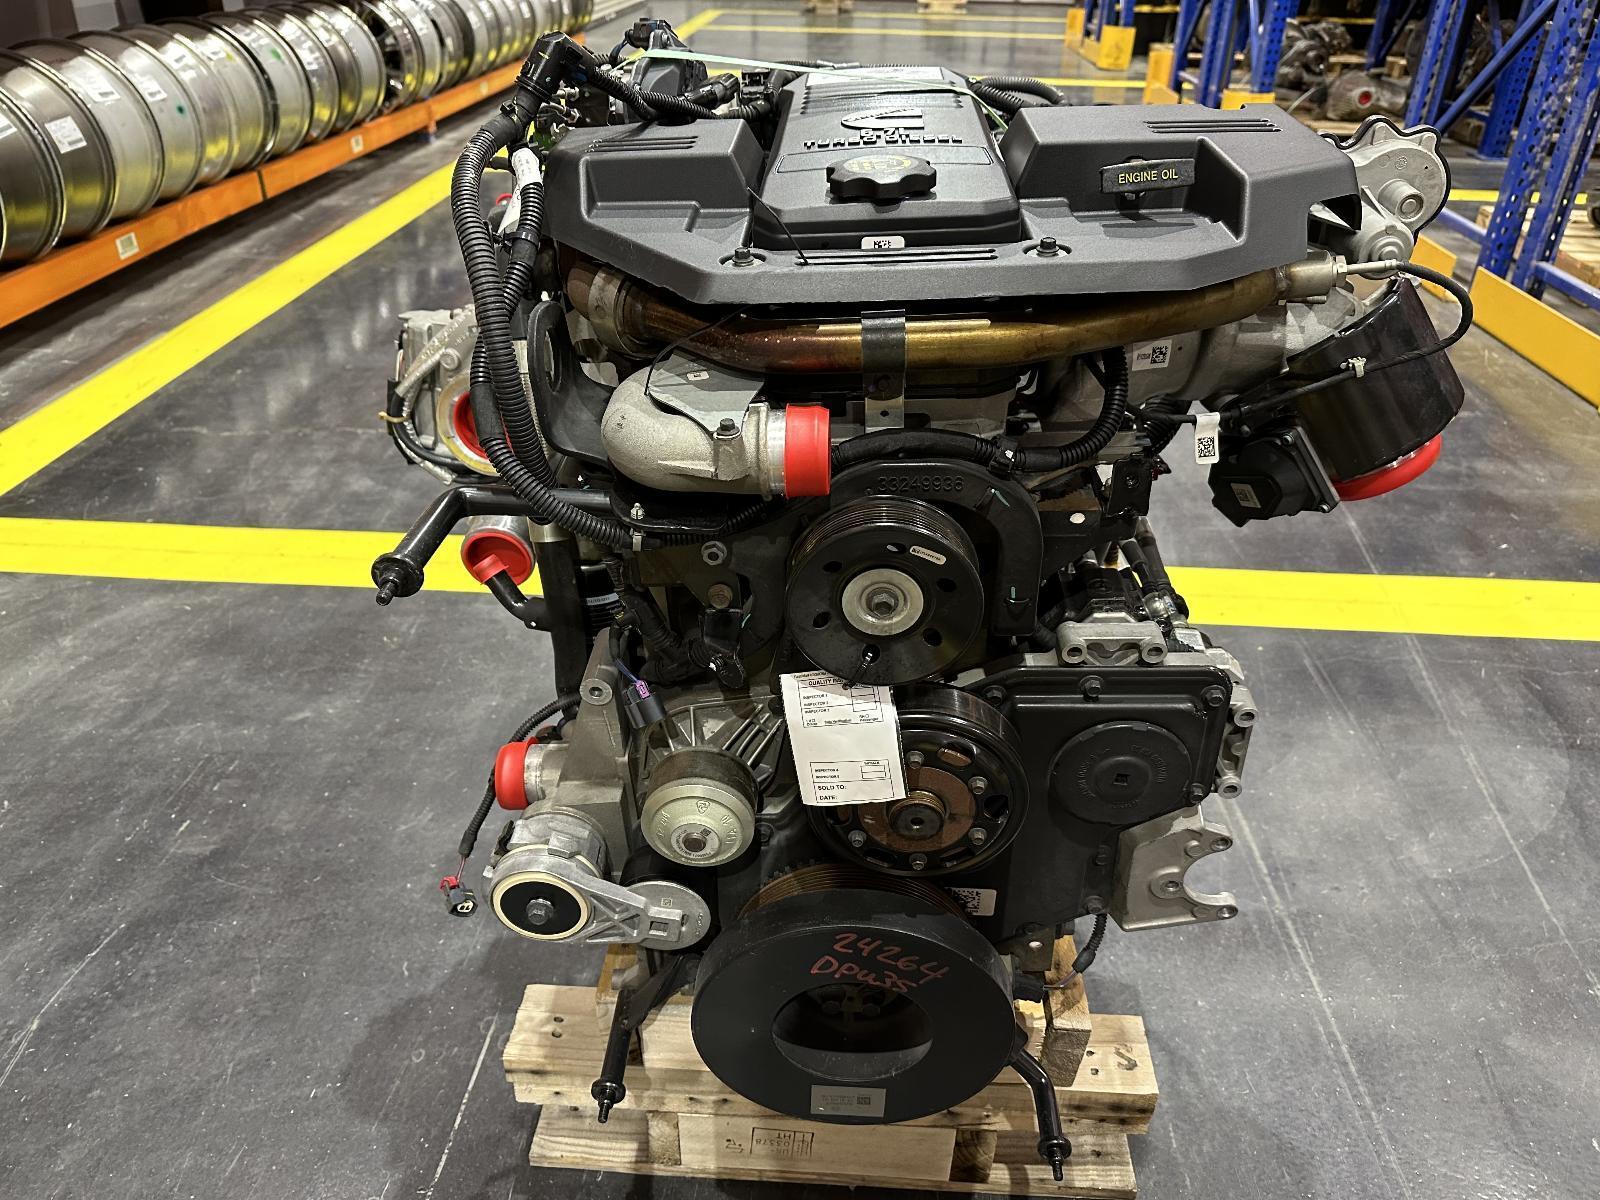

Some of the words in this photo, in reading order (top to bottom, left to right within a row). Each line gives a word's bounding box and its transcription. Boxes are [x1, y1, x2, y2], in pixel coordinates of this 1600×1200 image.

[804, 135, 877, 149] TURBO
[885, 133, 963, 145] DIESEL
[1118, 170, 1158, 184] ENGINE
[1161, 169, 1179, 180] OIL
[808, 678, 832, 686] QUALITY
[833, 932, 950, 984] 24264
